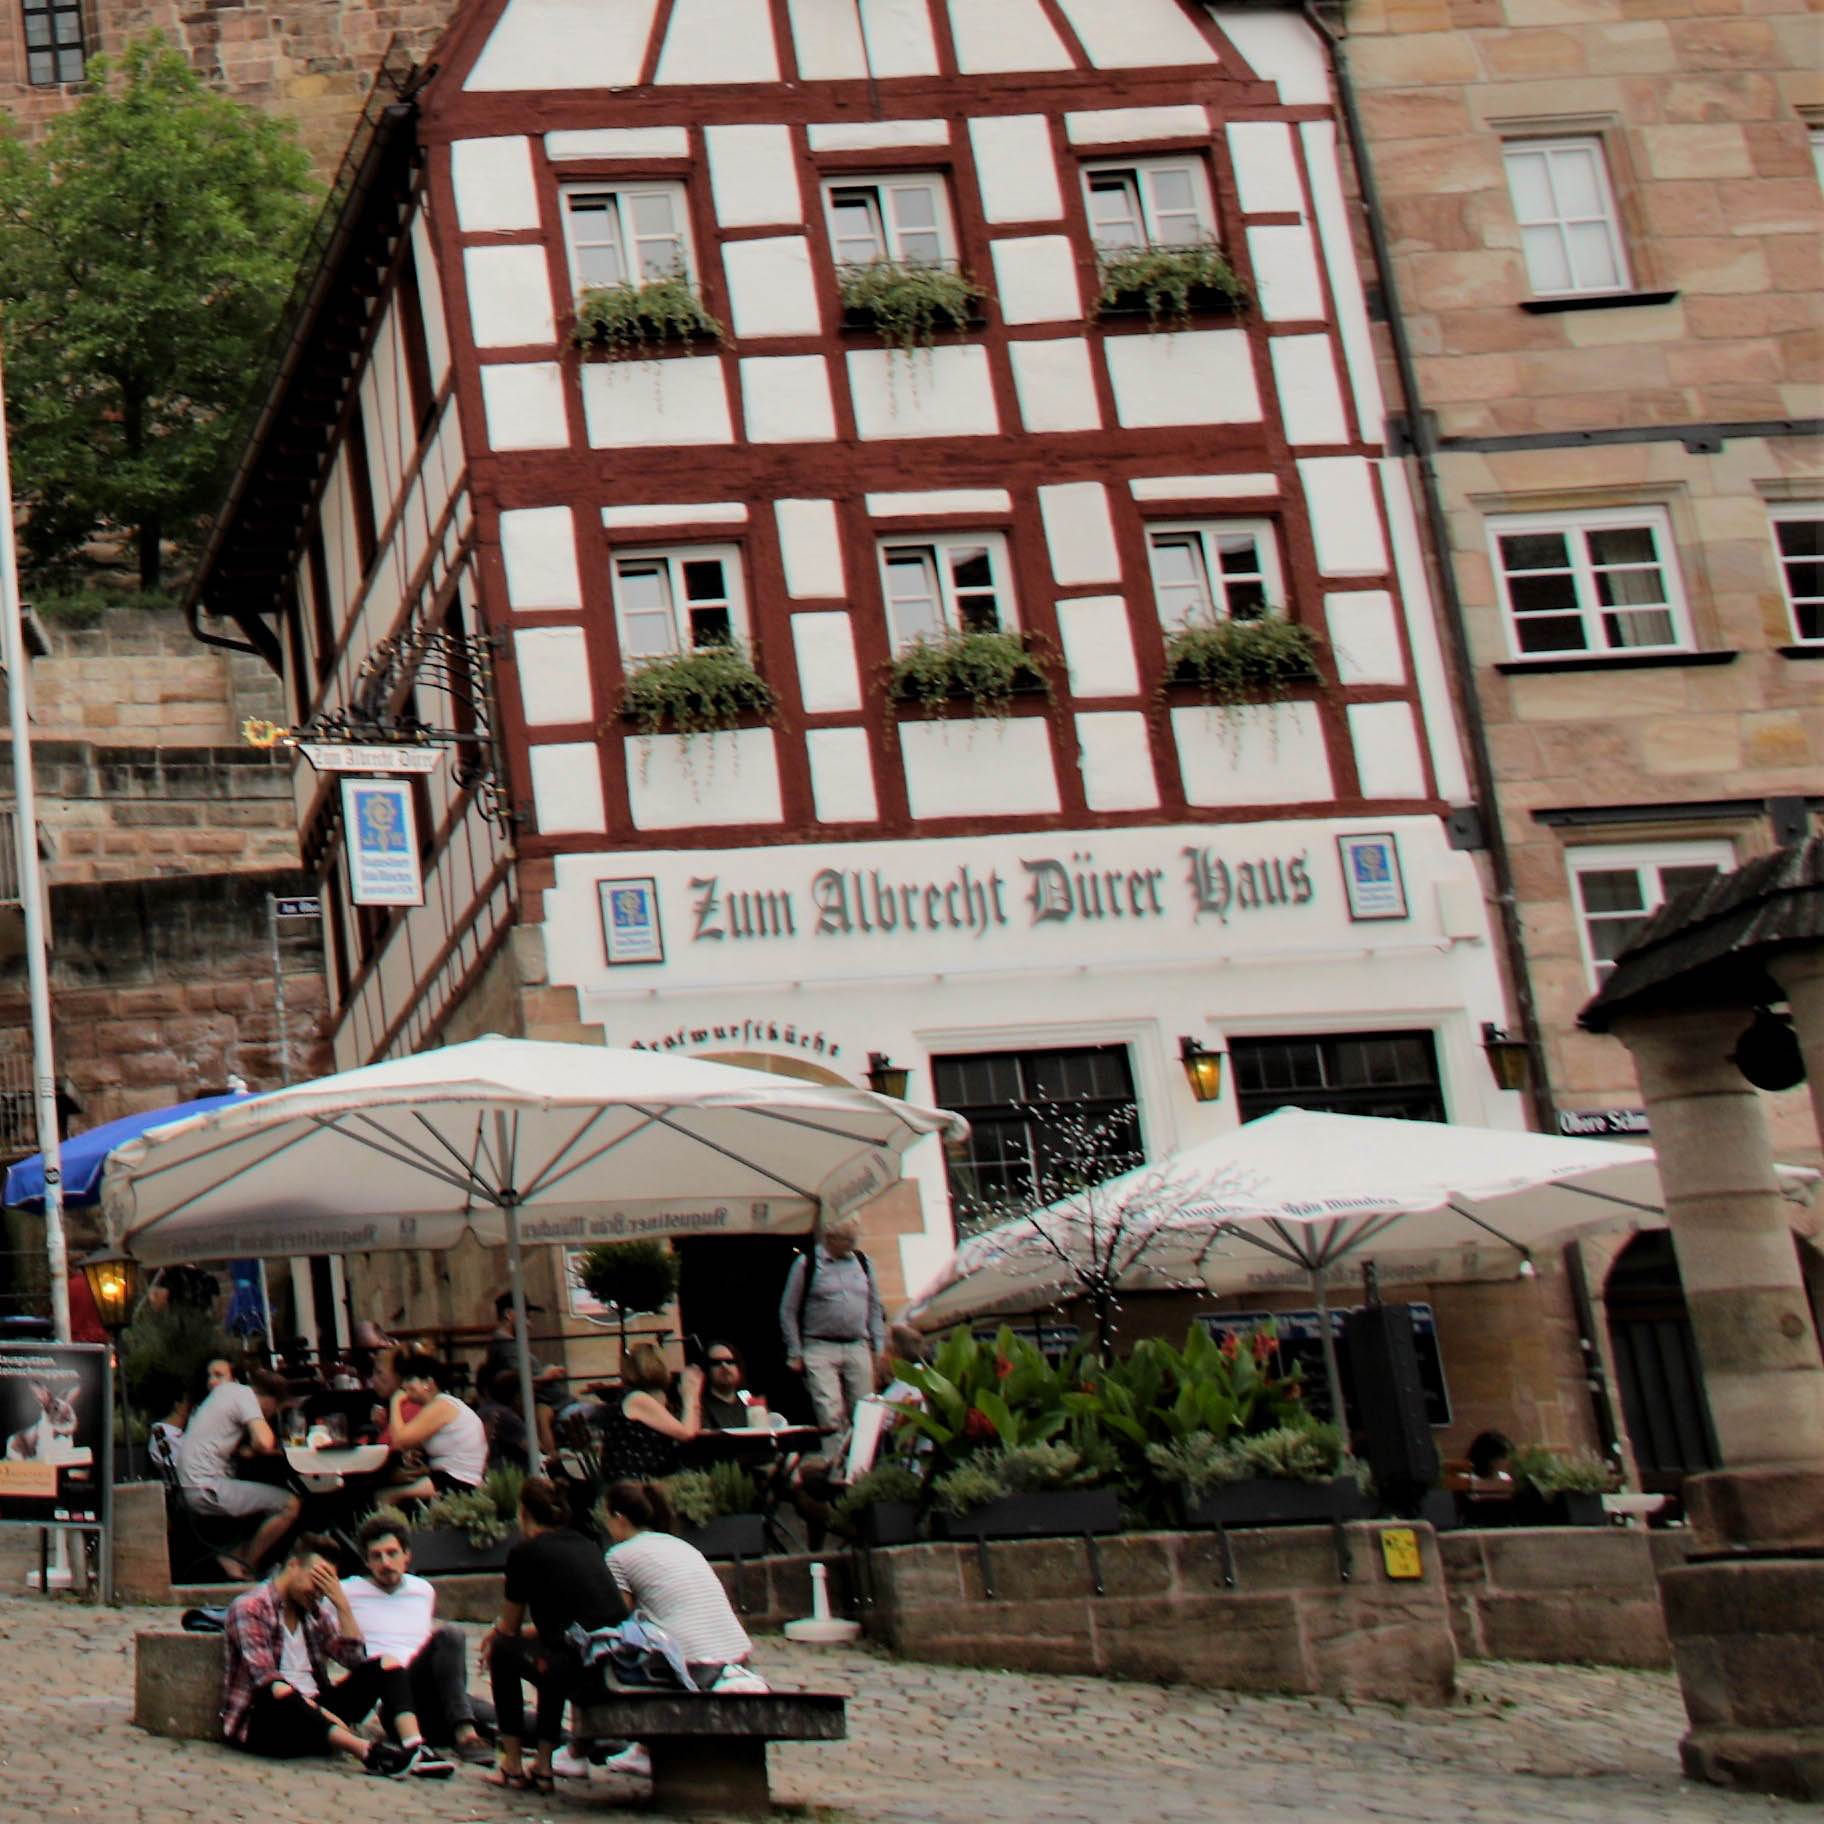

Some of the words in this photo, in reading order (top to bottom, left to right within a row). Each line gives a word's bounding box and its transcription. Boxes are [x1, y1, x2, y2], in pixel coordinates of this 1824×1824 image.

[688, 875, 795, 942] Zum
[811, 864, 1007, 941] Albrecht
[1019, 850, 1163, 927] Dürer
[1180, 846, 1313, 925] Haus
[1560, 1110, 1606, 1135] Obere
